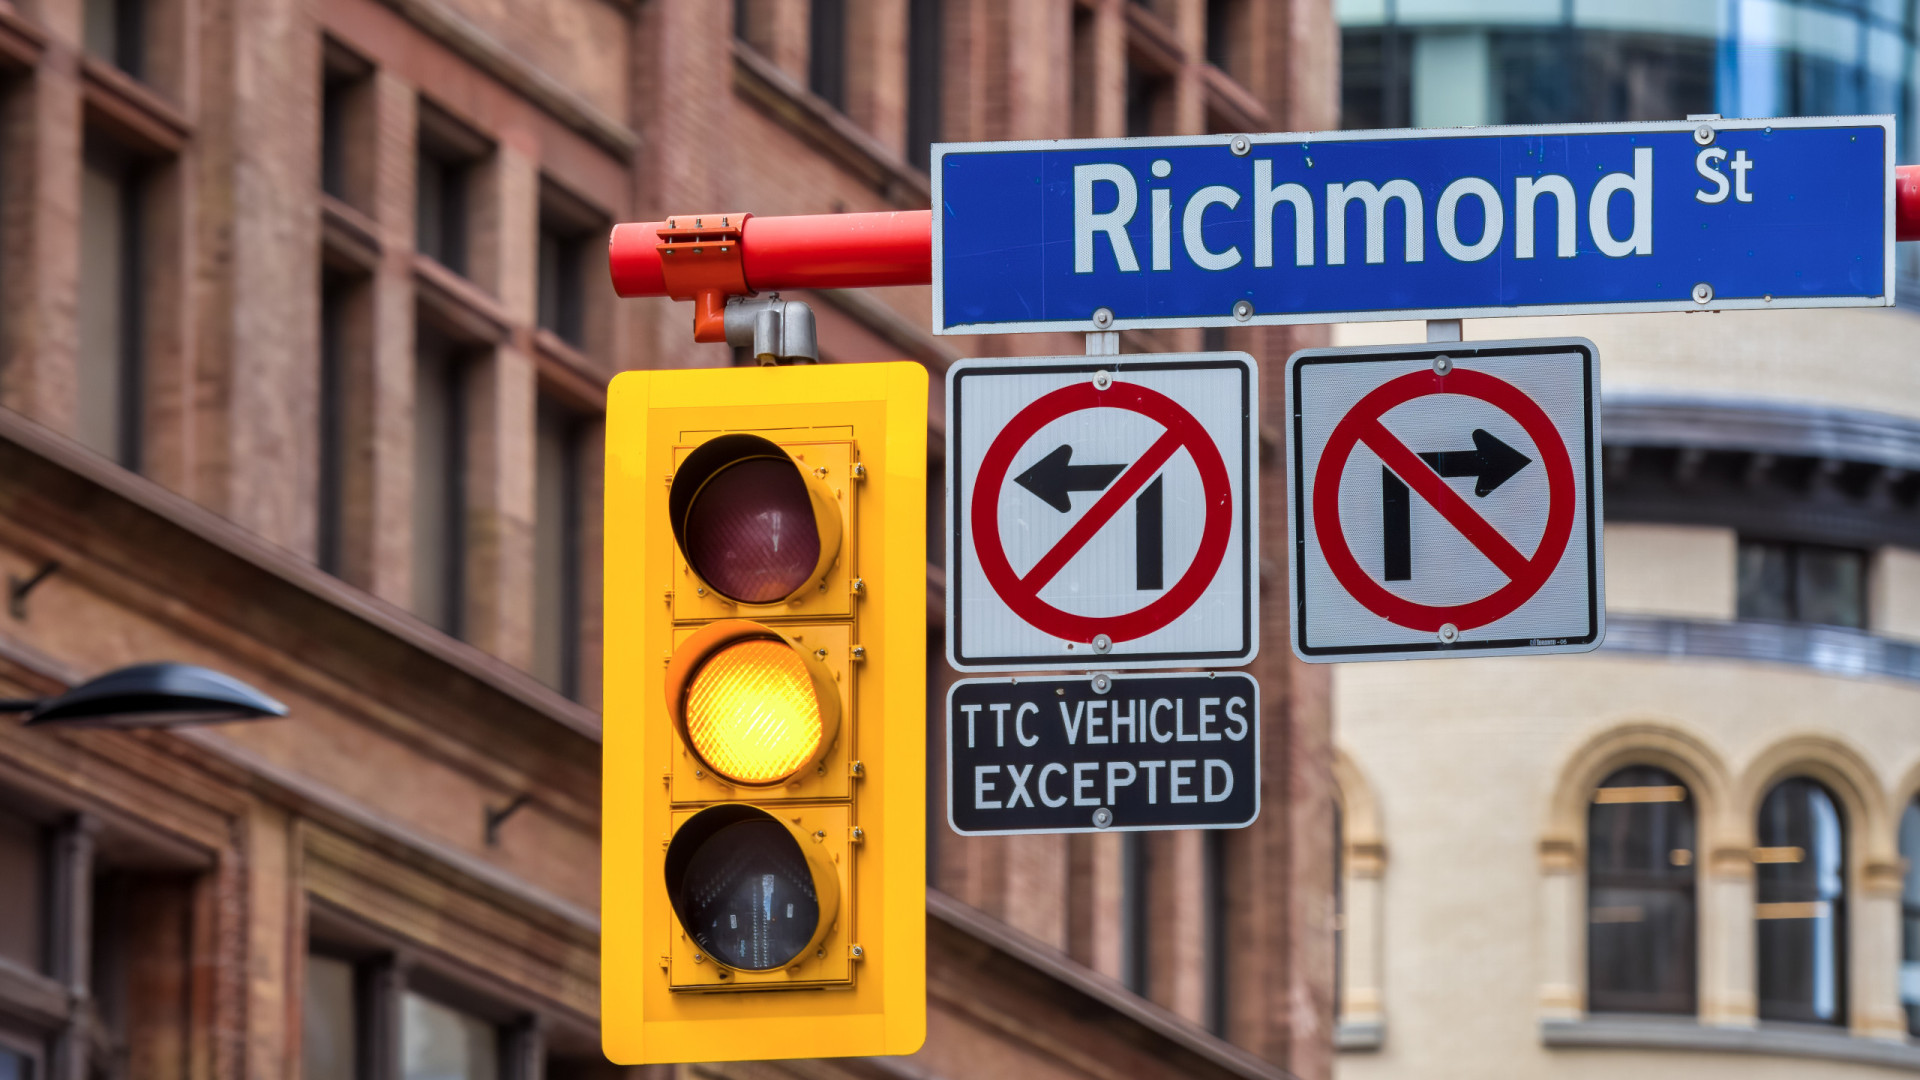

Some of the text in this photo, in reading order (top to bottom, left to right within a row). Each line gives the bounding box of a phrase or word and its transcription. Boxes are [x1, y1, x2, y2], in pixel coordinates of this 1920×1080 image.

[1073, 147, 1753, 273] Richmond St
[960, 696, 1249, 748] TTC VEHICLES
[974, 758, 1235, 809] EXCEPTED
